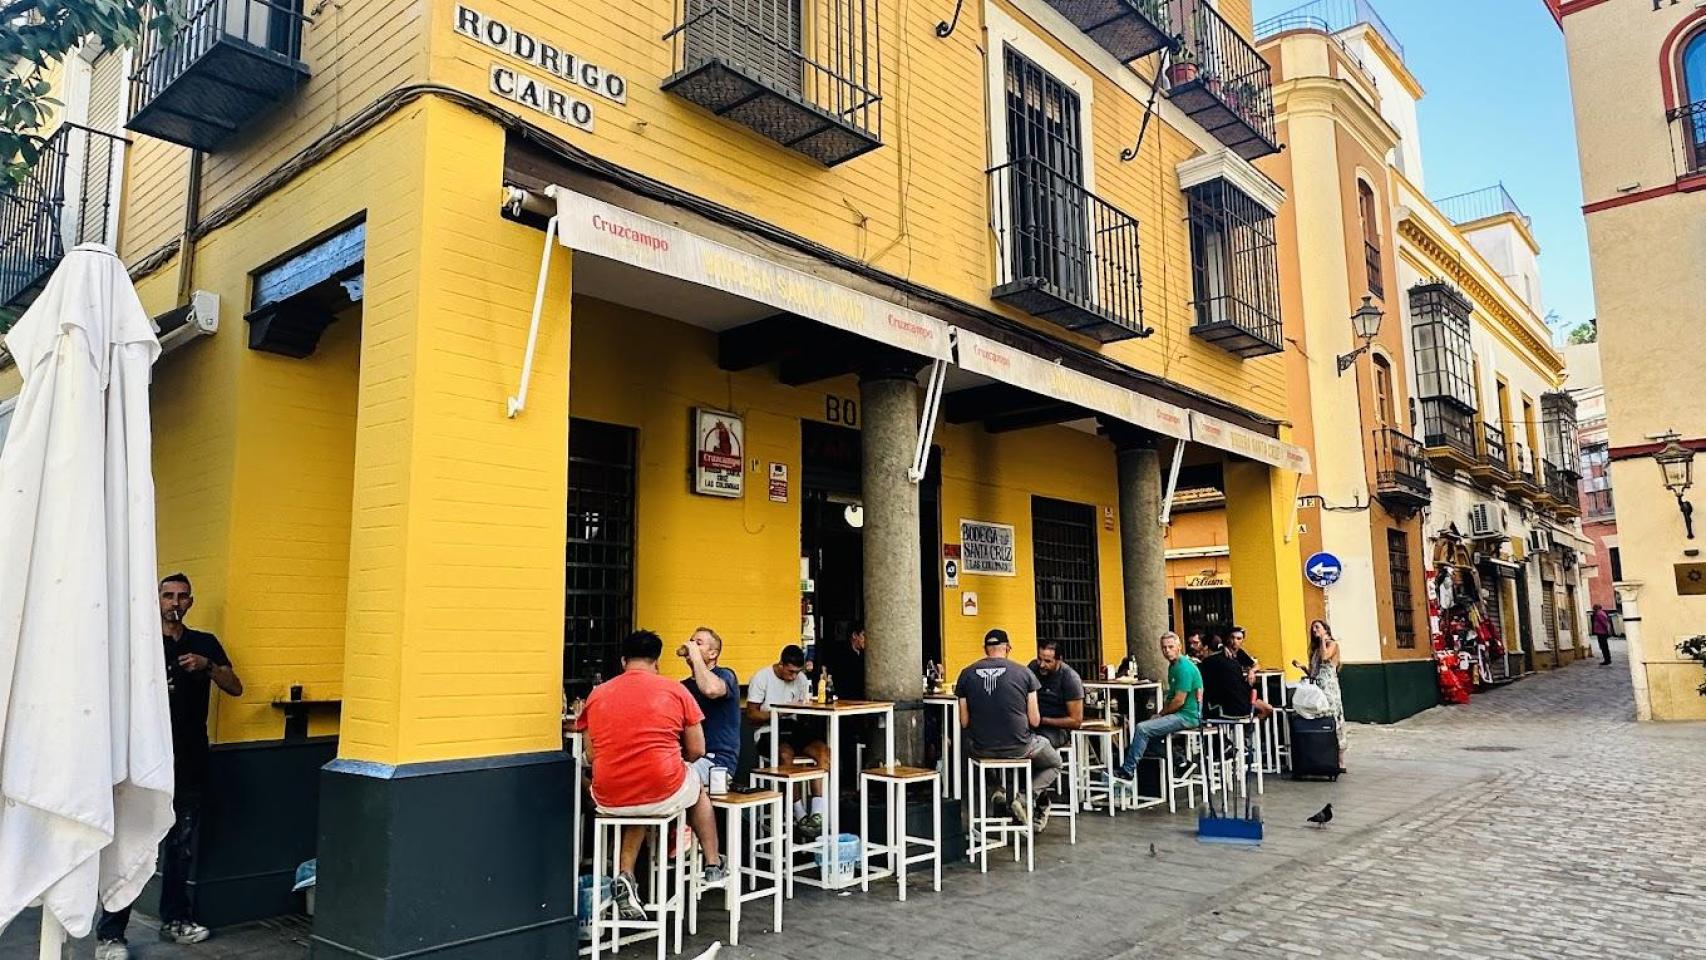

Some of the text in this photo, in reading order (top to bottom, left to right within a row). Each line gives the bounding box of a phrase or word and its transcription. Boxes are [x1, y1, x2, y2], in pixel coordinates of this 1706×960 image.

[458, 6, 624, 97] RODRIGO
[494, 69, 592, 124] CARO
[592, 215, 669, 252] Cruzcampo
[962, 523, 997, 543] BODEGA
[964, 542, 988, 560] SANTA
[990, 545, 1013, 562] CRUZ
